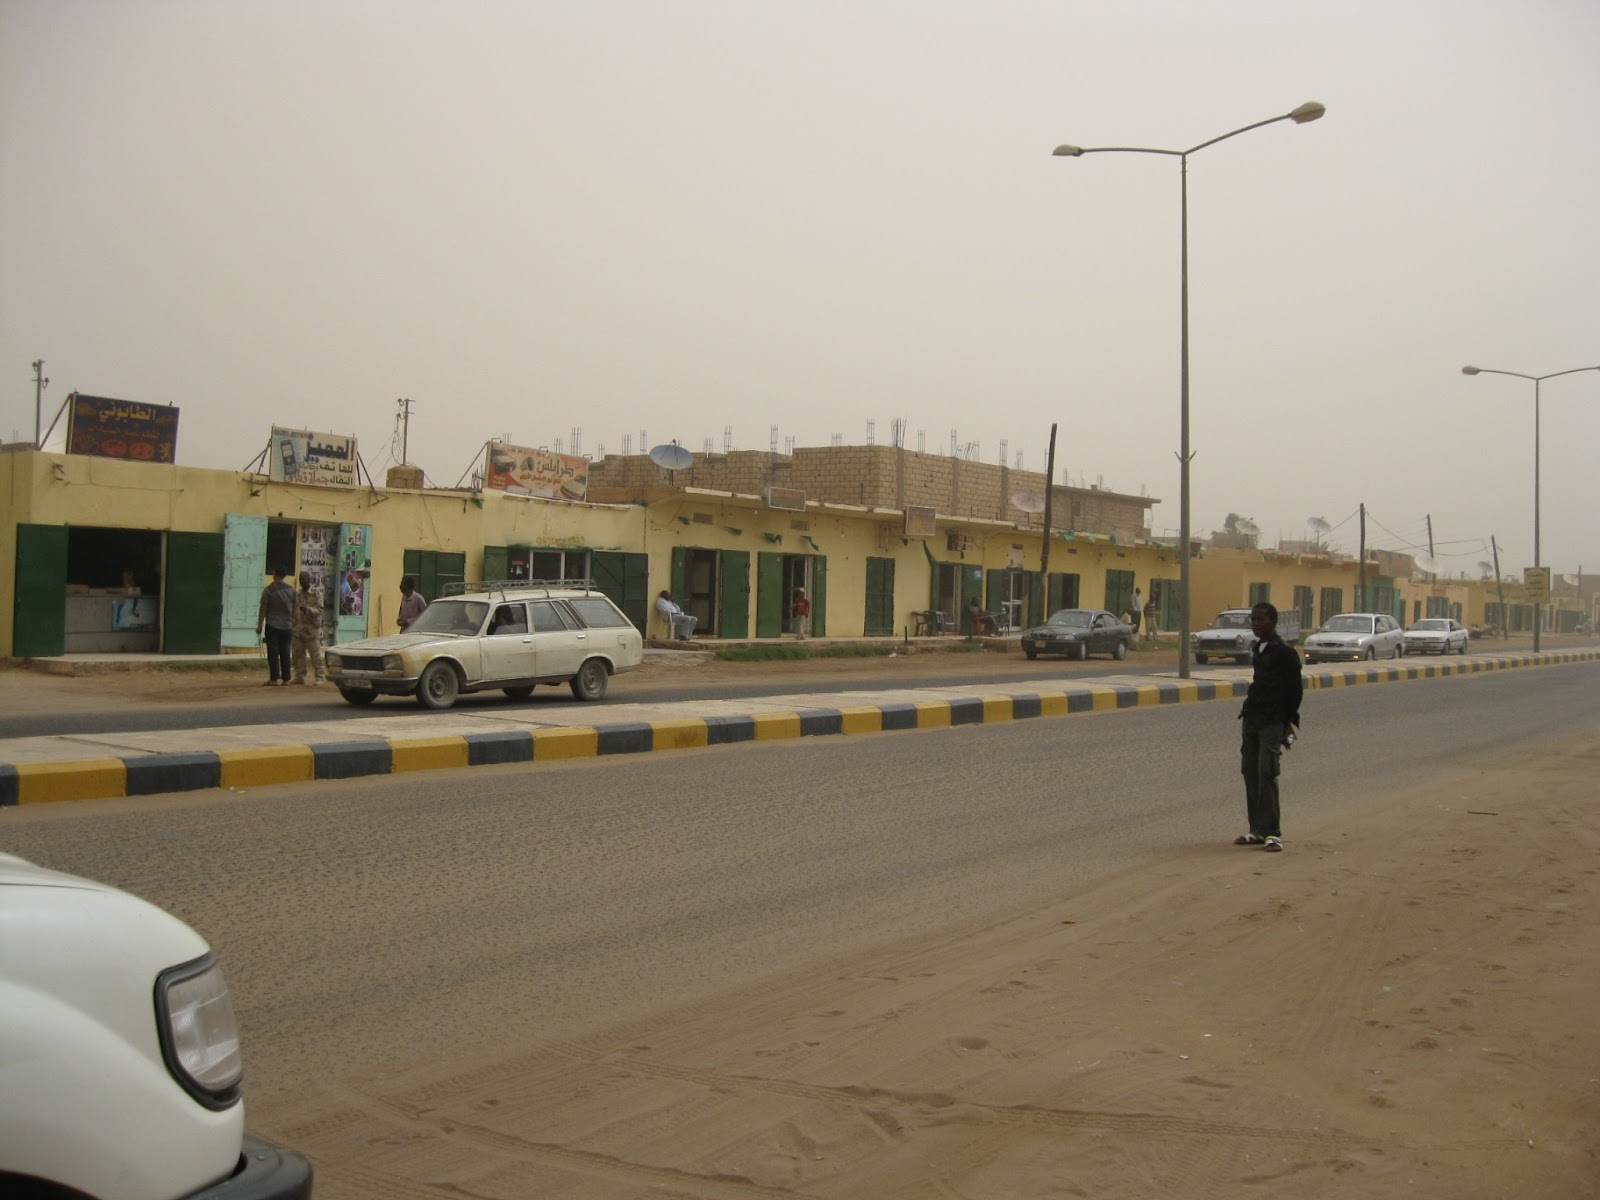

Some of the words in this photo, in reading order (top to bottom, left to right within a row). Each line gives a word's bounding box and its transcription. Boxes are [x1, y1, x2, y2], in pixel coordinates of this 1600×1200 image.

[305, 432, 355, 462] المميز
[537, 459, 574, 477] طرابلس
[331, 475, 353, 486] النقال
